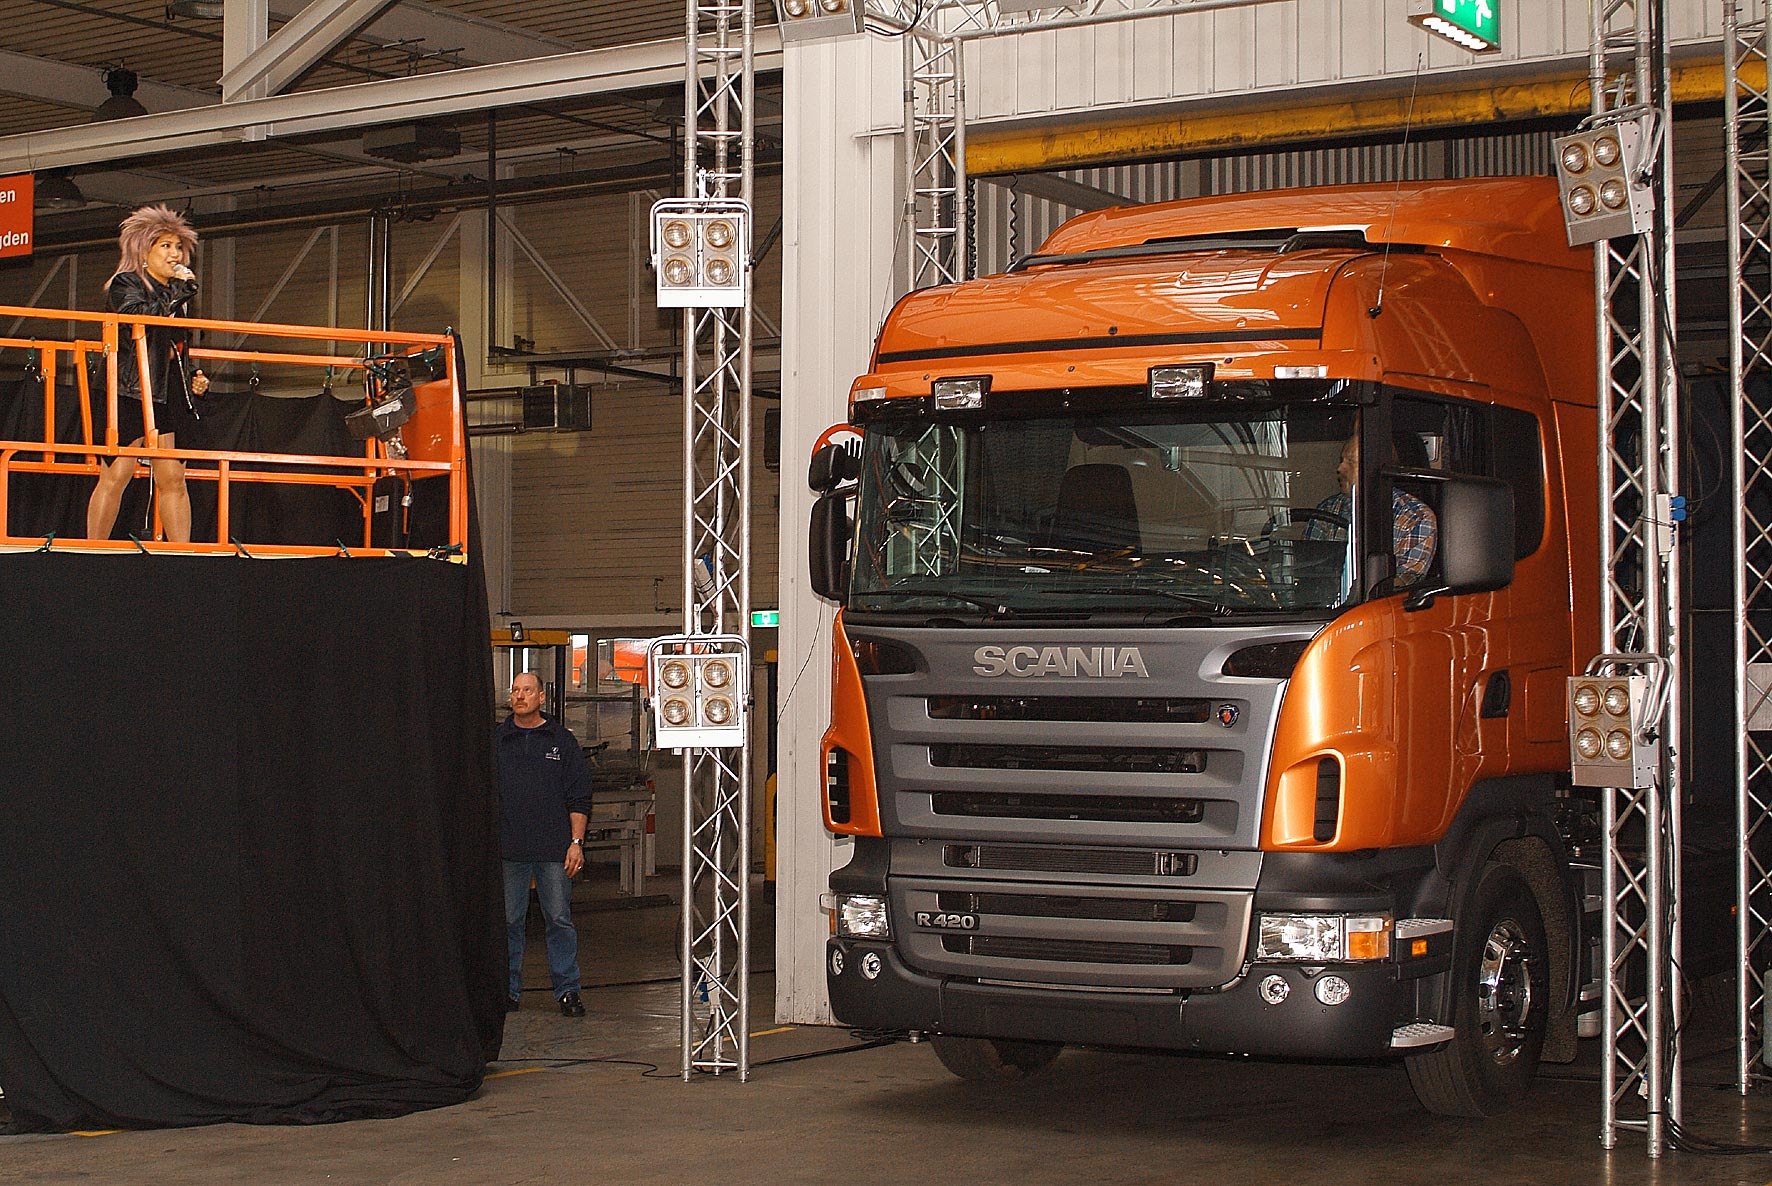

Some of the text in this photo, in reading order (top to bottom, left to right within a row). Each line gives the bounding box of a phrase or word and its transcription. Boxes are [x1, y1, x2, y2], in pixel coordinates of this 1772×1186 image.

[0, 231, 29, 250] den
[973, 645, 1150, 678] SCANIA
[917, 912, 975, 929] R 420
